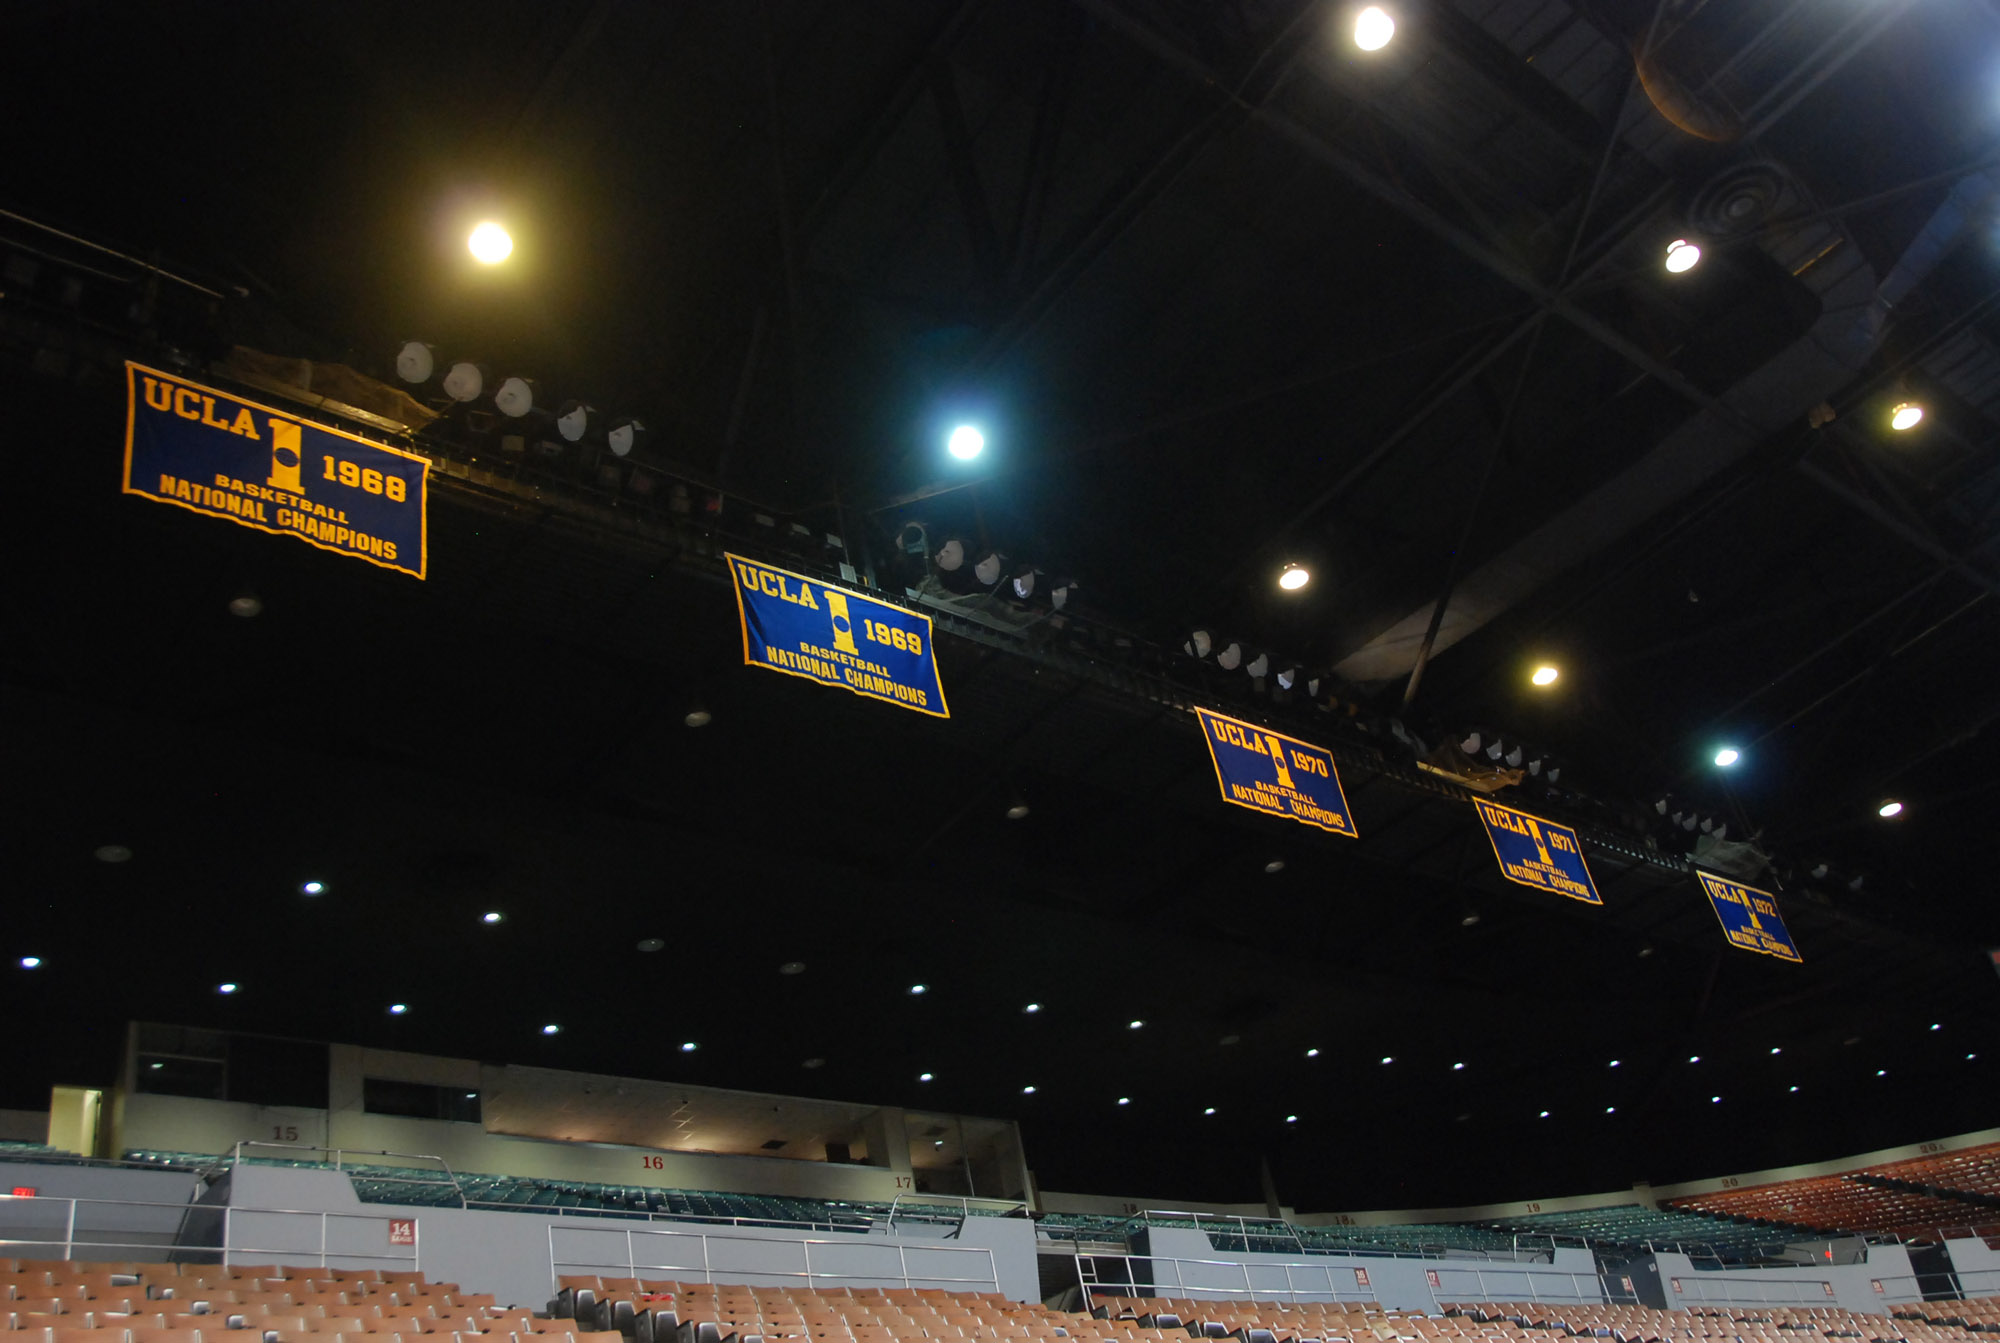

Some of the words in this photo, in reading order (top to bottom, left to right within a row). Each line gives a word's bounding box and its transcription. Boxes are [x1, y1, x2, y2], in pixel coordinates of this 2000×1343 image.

[143, 376, 261, 441] UCLA
[267, 418, 305, 495] 1
[323, 455, 406, 503] 1968
[160, 474, 267, 522] NATIONAL
[277, 508, 397, 560] CHAMPIONS
[214, 473, 349, 525] BASKETBALL
[737, 563, 819, 610] UCLA
[824, 590, 859, 656] 1
[864, 619, 922, 656] 1969
[766, 645, 840, 680] NATIONAL
[844, 669, 927, 706] CHAMPIONS
[800, 642, 891, 678] BASKETBALL
[1210, 718, 1269, 756] UCLA
[1264, 735, 1296, 789] 1
[1290, 750, 1329, 778] 1970
[1231, 783, 1284, 810] NATIONAL
[1290, 799, 1345, 828] CHAMPIONS
[1255, 780, 1317, 806] BASKETBALL
[1484, 806, 1530, 836] UCLA
[1525, 819, 1554, 866] 1
[1547, 830, 1576, 854] 1971
[1506, 862, 1547, 884] NATIONAL
[1522, 858, 1569, 879] BASKETBALL
[1706, 879, 1742, 904] UCLA
[1737, 888, 1763, 929] 1
[273, 1126, 298, 1141] 15
[643, 1156, 664, 1169] 16
[896, 1176, 911, 1189] 17
[1527, 1203, 1540, 1213] 19
[393, 1222, 411, 1236] 14
